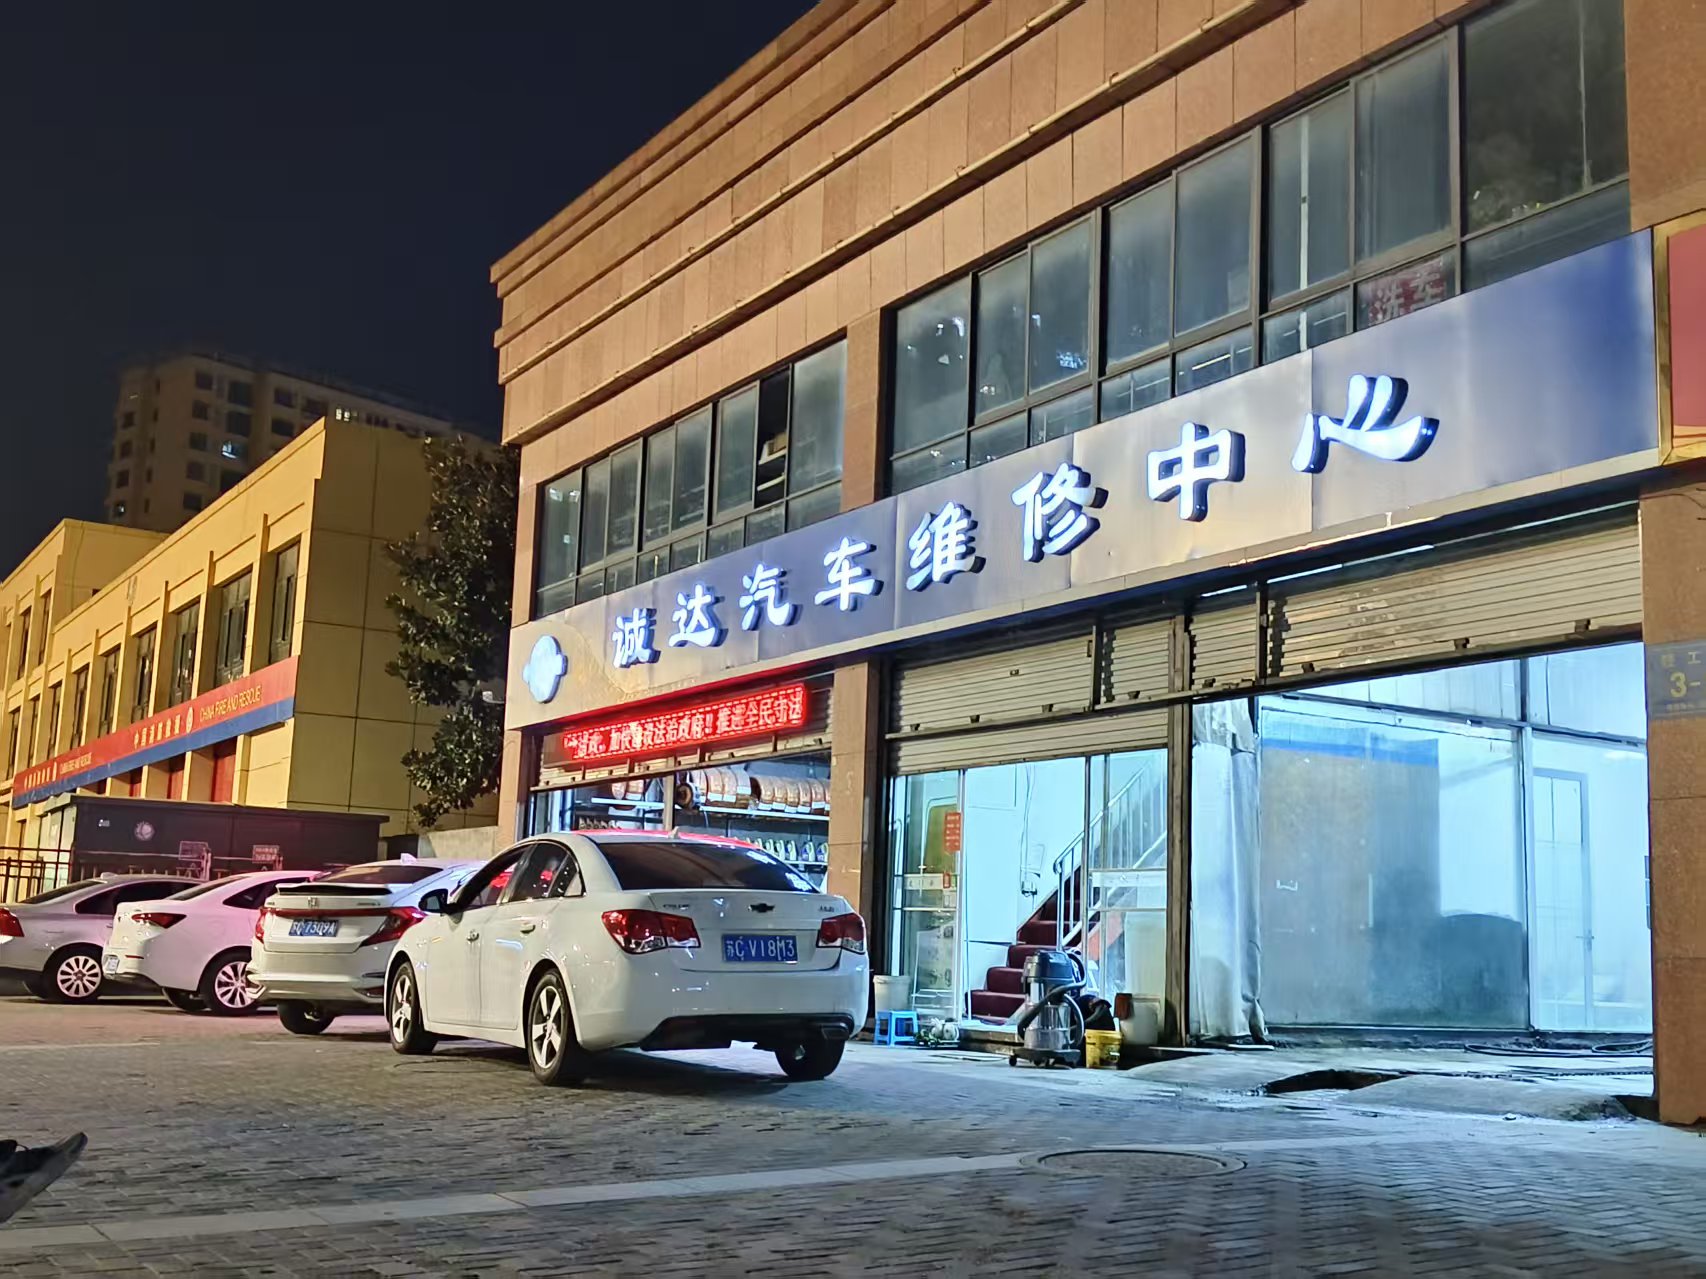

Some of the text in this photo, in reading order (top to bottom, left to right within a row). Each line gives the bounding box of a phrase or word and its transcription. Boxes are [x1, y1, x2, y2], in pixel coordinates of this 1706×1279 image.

[612, 374, 1438, 668] 诚达汽车维修中心
